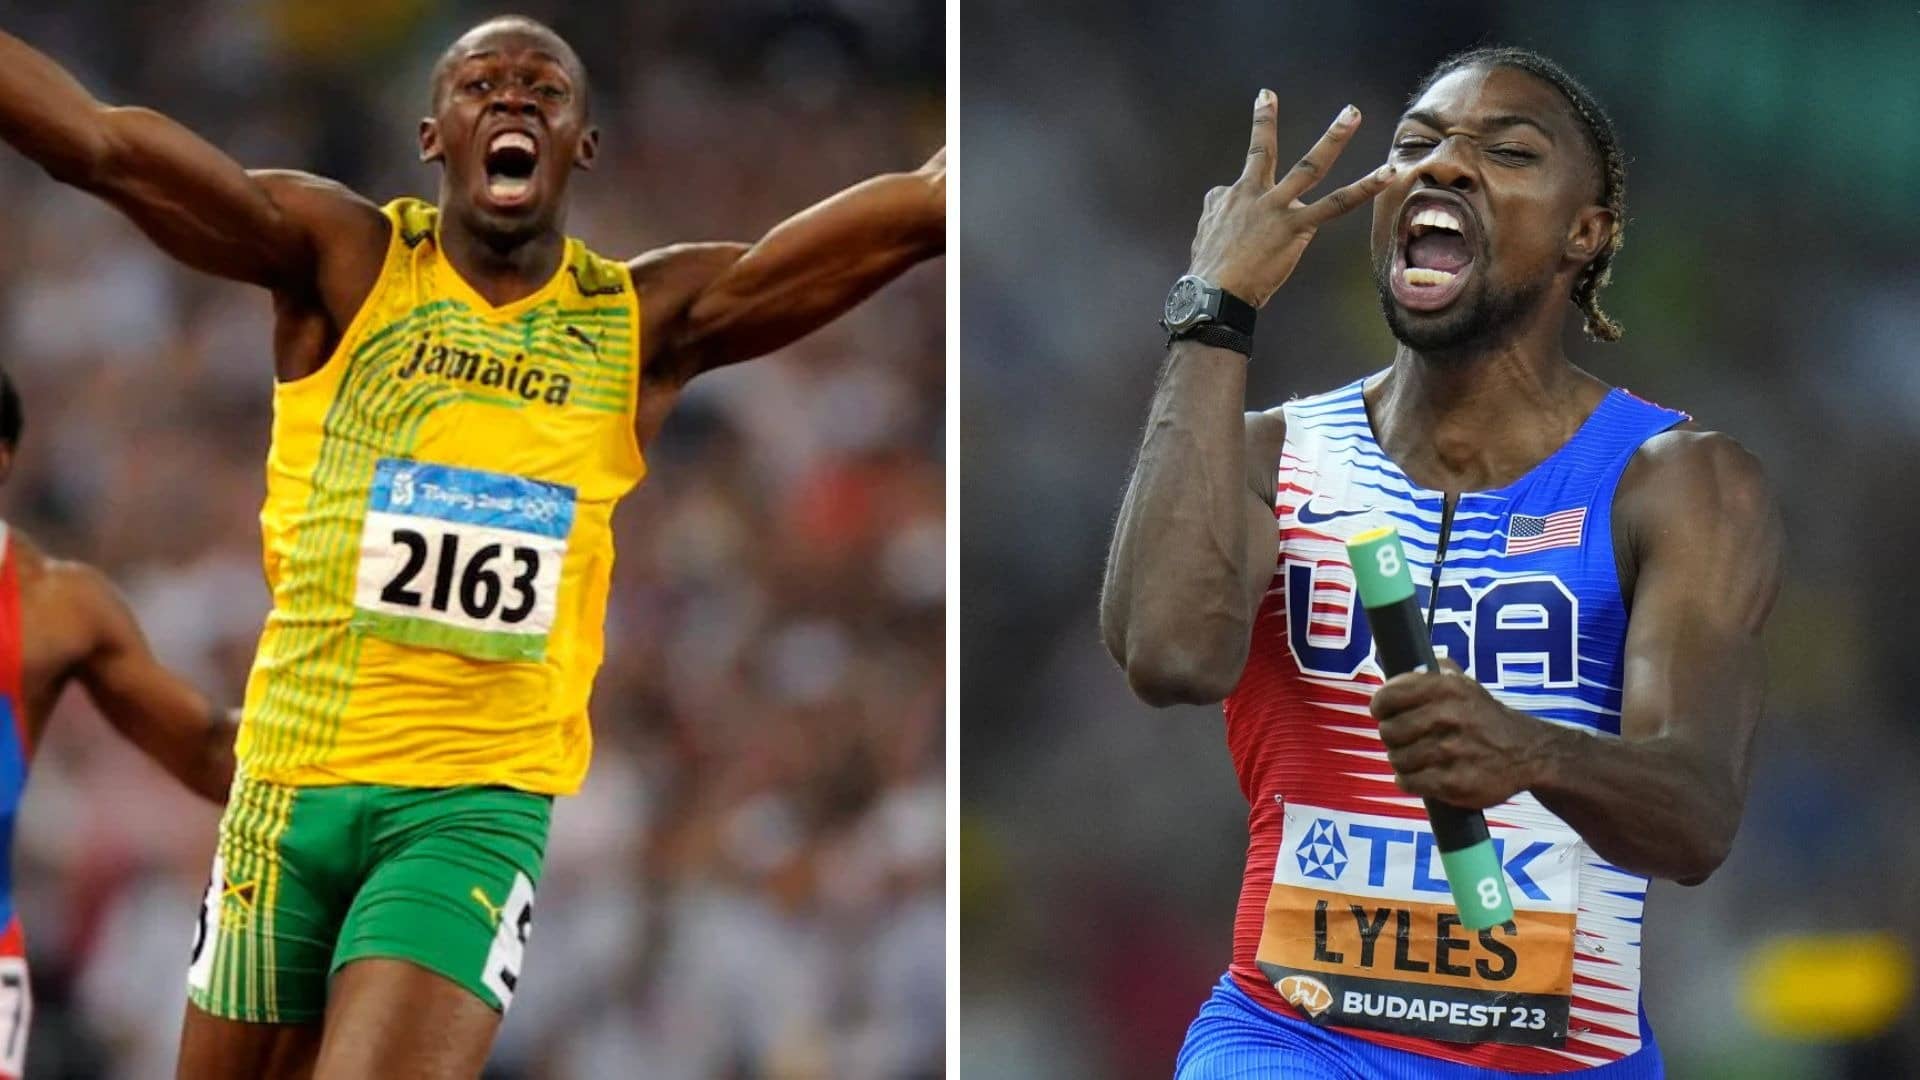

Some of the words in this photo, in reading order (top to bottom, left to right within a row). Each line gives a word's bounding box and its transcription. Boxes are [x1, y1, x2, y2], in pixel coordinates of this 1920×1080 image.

[398, 330, 572, 406] jamaica
[380, 528, 540, 624] 2163
[1376, 544, 1401, 578] 8
[1476, 876, 1502, 910] 8
[1313, 899, 1518, 981] LYLES
[1342, 991, 1506, 1027] BUDAPEST
[1510, 1007, 1546, 1030] 23
